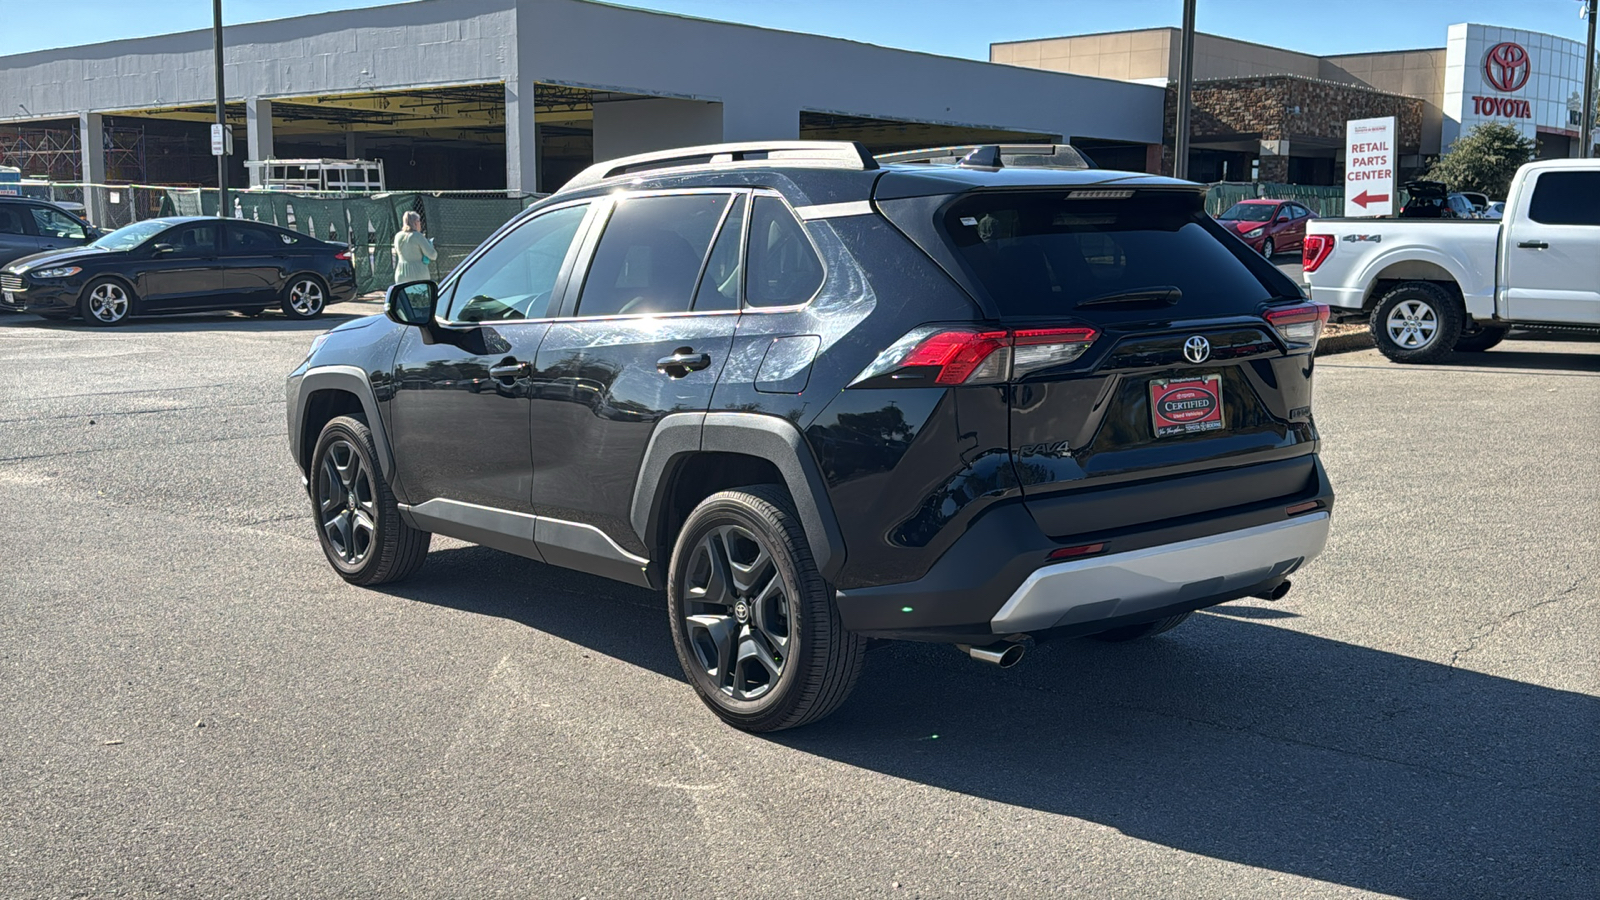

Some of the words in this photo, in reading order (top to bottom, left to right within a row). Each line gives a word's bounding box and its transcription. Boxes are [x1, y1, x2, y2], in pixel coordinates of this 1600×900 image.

[1472, 96, 1531, 118] TOYOTA
[1351, 141, 1389, 154] RETAIL
[1352, 155, 1387, 167] PARTS
[1347, 169, 1392, 182] CENTER
[1164, 399, 1210, 412] CERTIFIED
[1019, 440, 1069, 456] RAV4
